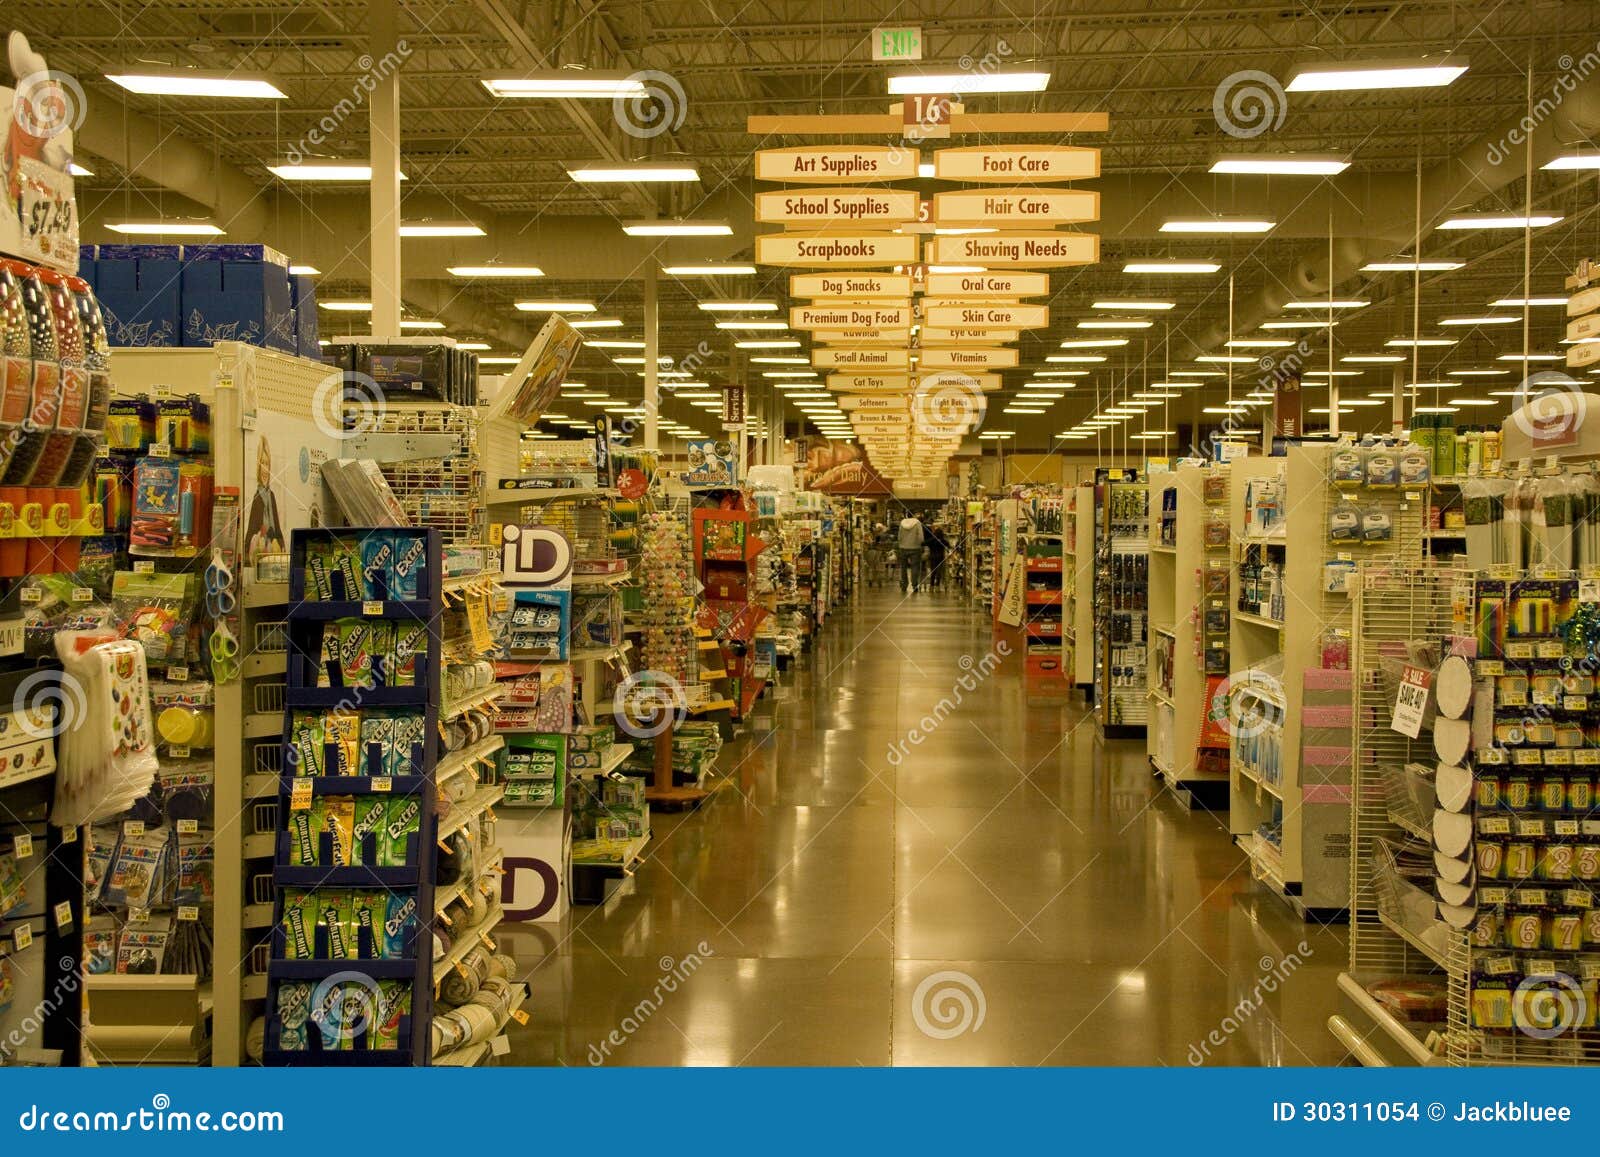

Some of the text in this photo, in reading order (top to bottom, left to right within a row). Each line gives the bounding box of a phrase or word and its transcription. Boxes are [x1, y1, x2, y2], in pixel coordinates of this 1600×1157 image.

[881, 31, 913, 56] EXIT
[914, 97, 940, 122] 16
[794, 155, 877, 176] Art Supplies
[983, 155, 1050, 172] Foot Care
[29, 200, 71, 235] $7.49
[785, 198, 889, 219] School Supplies
[984, 198, 1050, 214] Hair Care
[798, 241, 875, 261] Scrapbooks
[965, 240, 1067, 261] Shaving Needs
[822, 279, 881, 294] Dog Snacks
[907, 266, 924, 282] 14
[962, 278, 1011, 291] Oral Care
[803, 311, 900, 326] Premium Dog Food
[962, 309, 1011, 322] Skin Care
[968, 329, 987, 337] Care
[834, 352, 888, 363] Small Animal
[950, 352, 987, 363] Vitamins
[853, 378, 883, 387] Cat Toys
[731, 388, 740, 422] Service
[859, 399, 888, 407] Softeners
[1283, 418, 1294, 436] WINE
[841, 470, 868, 486] Daily
[396, 539, 424, 578] Extra
[341, 625, 363, 656] Extra
[396, 718, 424, 754] Extra
[299, 729, 318, 776] DOUBLEMINT
[354, 802, 384, 840] Extra
[388, 801, 418, 840] Extra
[297, 815, 314, 864] DOUBLEMINT
[1479, 845, 1498, 871] 0
[1514, 847, 1529, 875] 1
[1553, 847, 1572, 874] 2
[1580, 848, 1599, 874] 3
[386, 898, 416, 937] Extra
[1520, 917, 1537, 942] 6
[290, 908, 308, 959] DOUBLEMINT
[326, 910, 345, 959] DOUBLEMINT
[1560, 917, 1580, 945] 7
[280, 984, 310, 1023] Extra
[311, 985, 342, 1023] Extra
